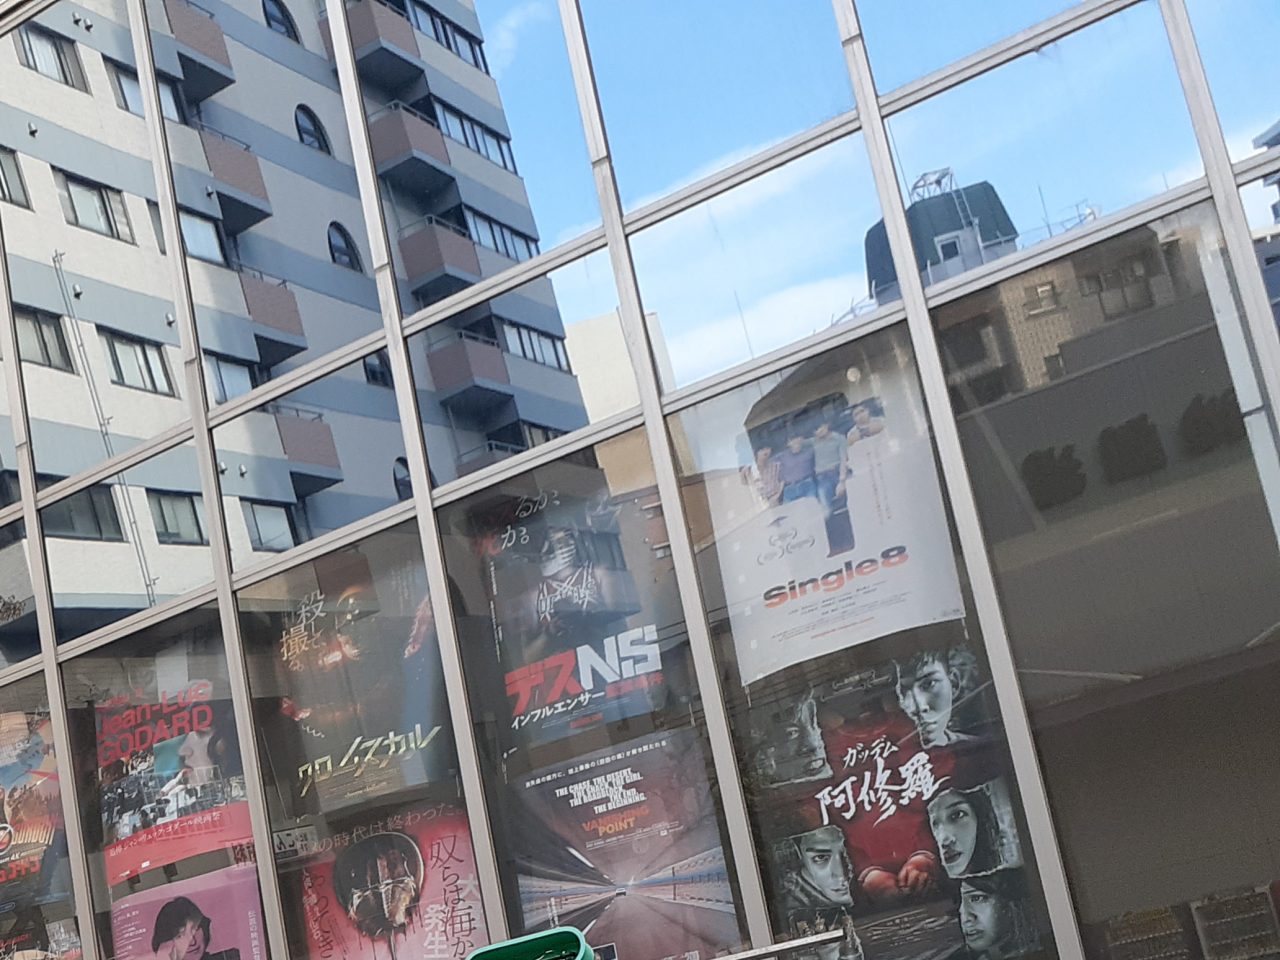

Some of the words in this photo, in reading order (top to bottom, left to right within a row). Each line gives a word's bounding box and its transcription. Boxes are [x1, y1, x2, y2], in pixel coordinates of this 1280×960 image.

[814, 751, 951, 828] 阿修羅
[597, 816, 637, 837] POINT
